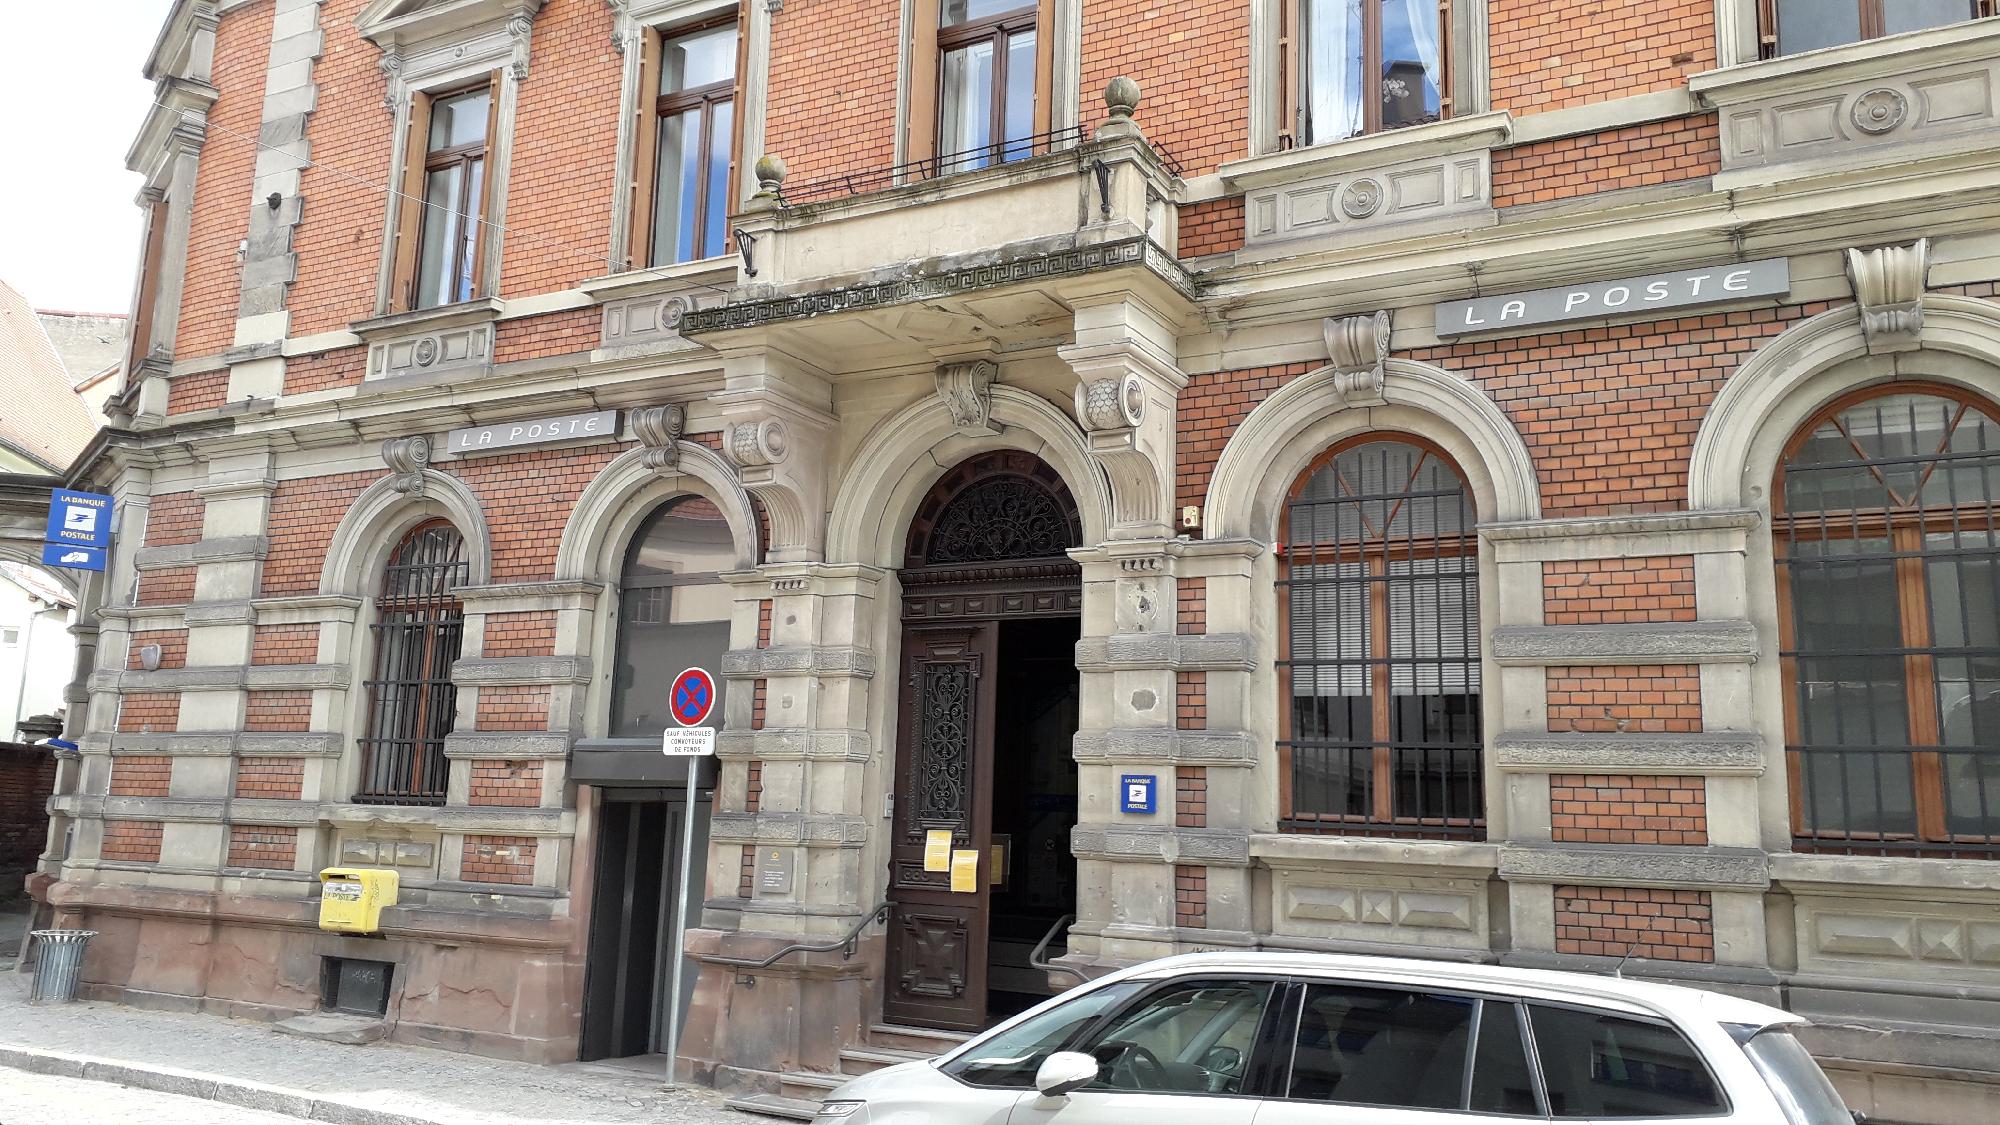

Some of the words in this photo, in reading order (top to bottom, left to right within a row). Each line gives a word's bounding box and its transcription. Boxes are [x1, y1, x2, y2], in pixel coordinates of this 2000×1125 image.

[1465, 300, 1526, 326] LA
[1564, 270, 1751, 313] POSTE
[461, 431, 493, 447] LA
[510, 417, 600, 441] POSTE
[72, 497, 106, 507] BANQUE
[60, 530, 95, 541] POSTALE
